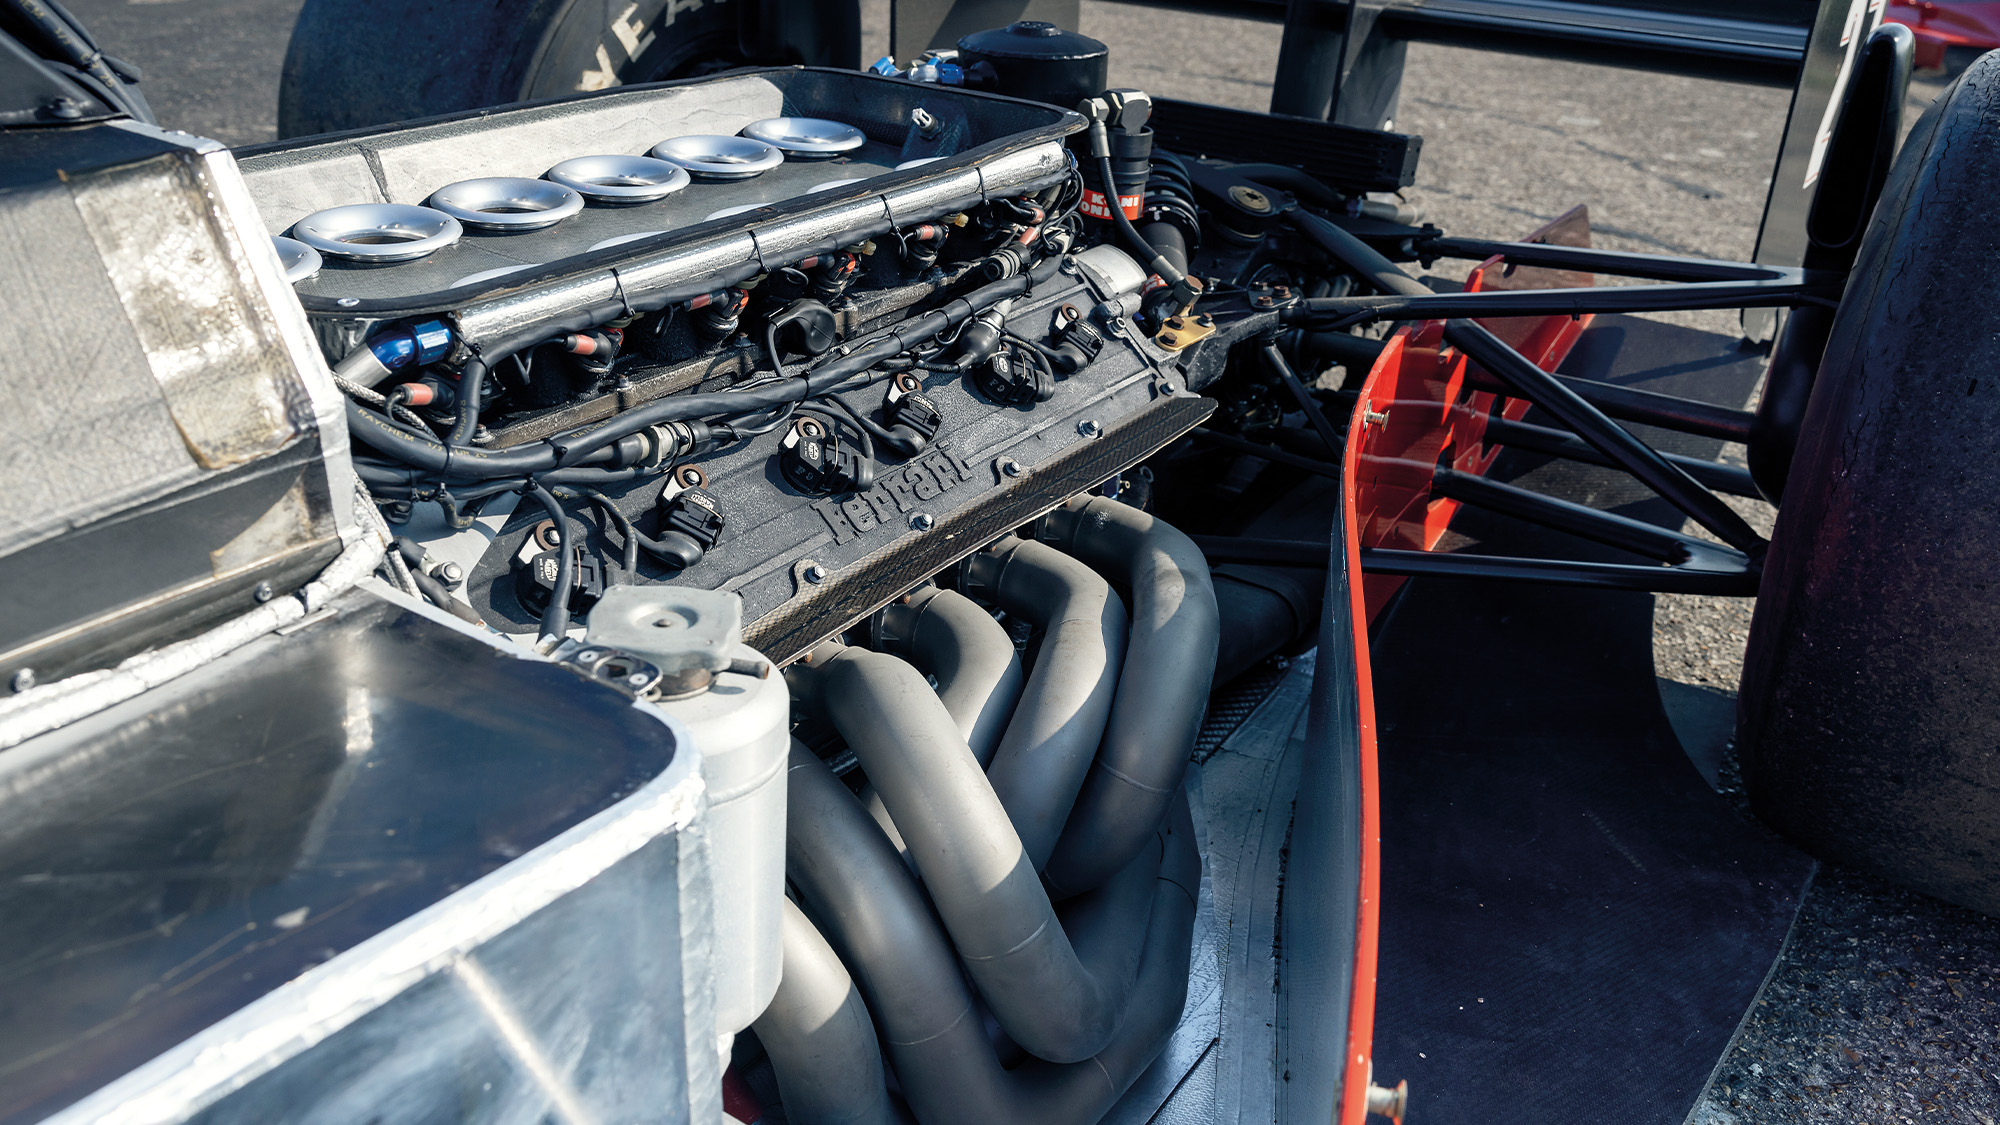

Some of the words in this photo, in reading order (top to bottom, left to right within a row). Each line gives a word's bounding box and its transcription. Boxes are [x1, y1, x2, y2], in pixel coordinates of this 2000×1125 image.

[1091, 193, 1139, 208] KNI
[357, 408, 415, 443] RAYCHEM
[809, 440, 973, 546] Ferrari
